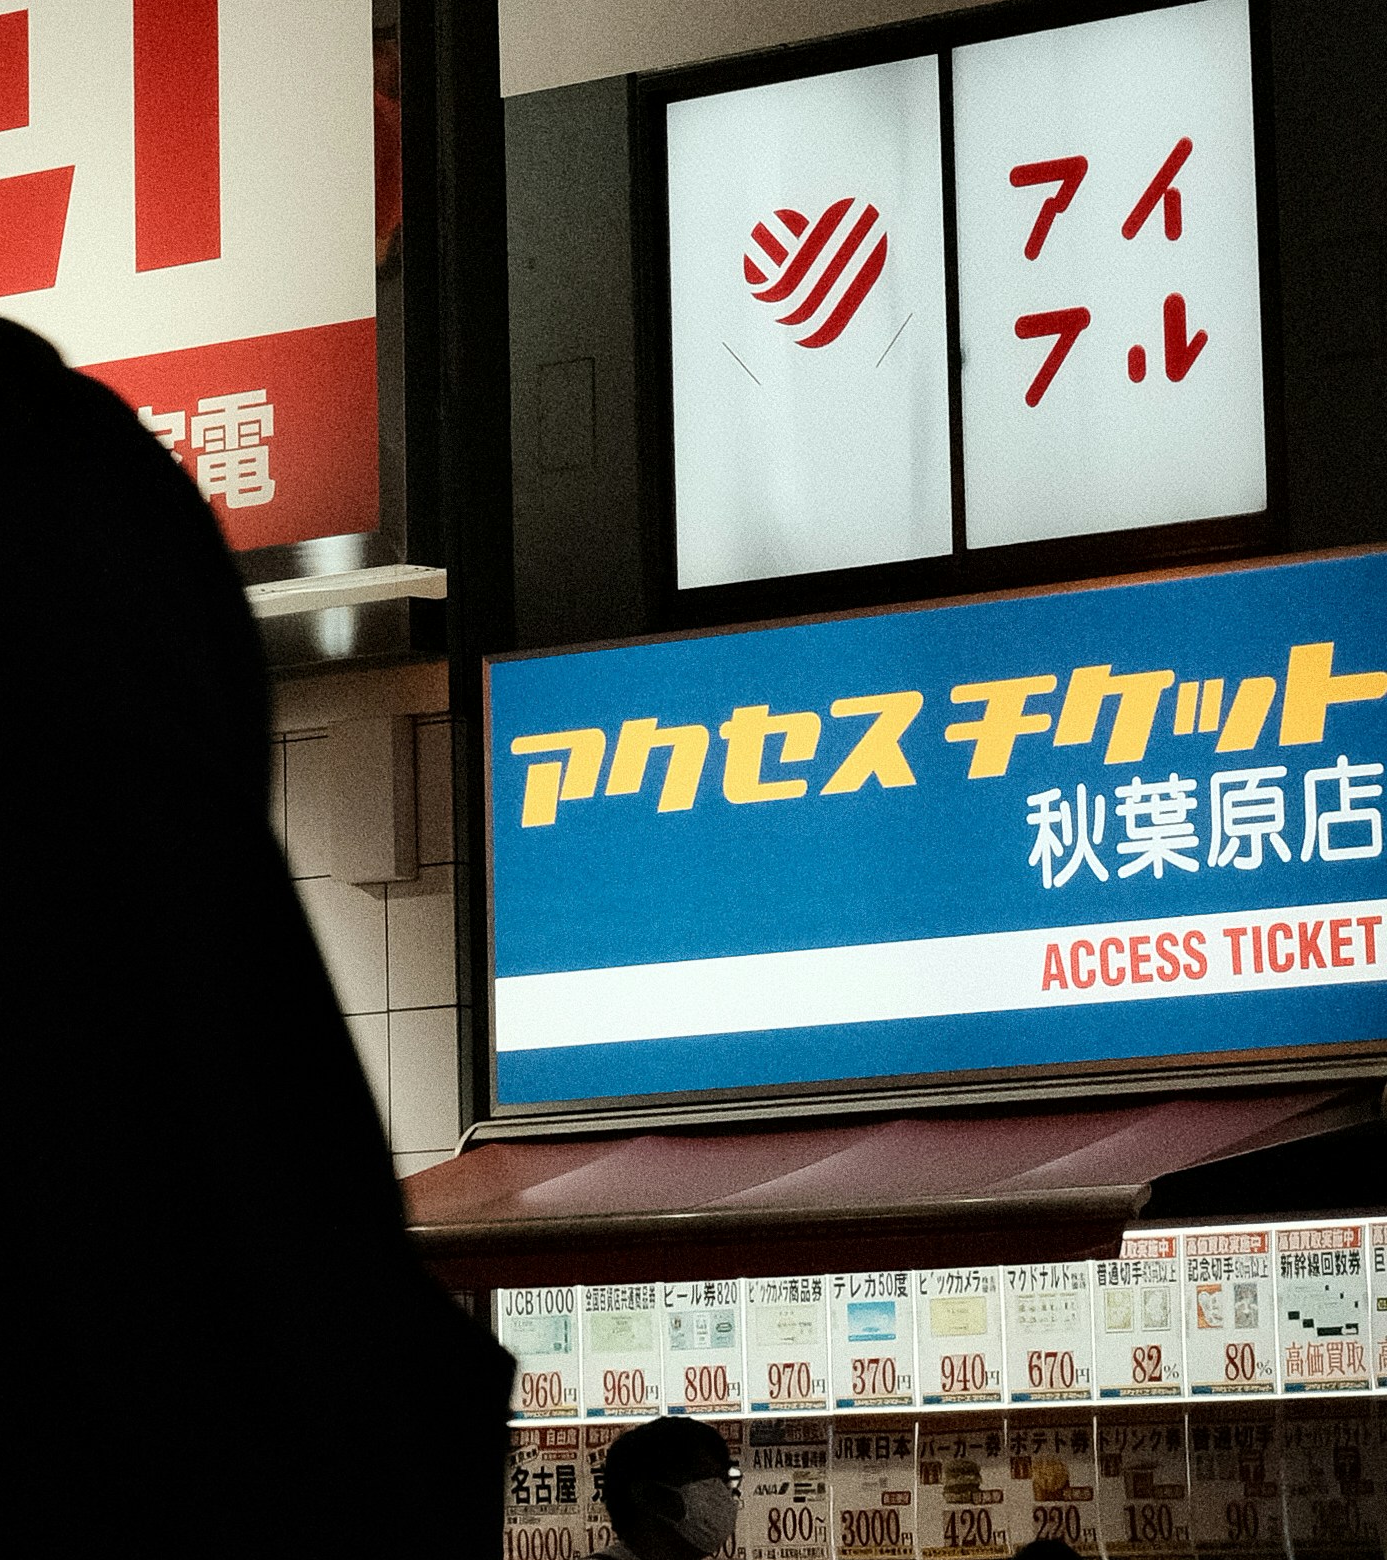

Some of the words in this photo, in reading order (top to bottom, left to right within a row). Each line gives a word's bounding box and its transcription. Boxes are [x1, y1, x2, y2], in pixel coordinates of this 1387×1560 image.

[1027, 755, 1385, 890] 秋葉原店
[1041, 930, 1208, 993] ACCESS
[1221, 916, 1383, 976] TICKET
[1280, 1252, 1361, 1280] 新幹線回数券
[505, 1288, 575, 1316] JCB1000
[663, 1281, 737, 1307] ビール券820
[833, 1272, 909, 1299] テレカ50度
[851, 1357, 912, 1395] 370円
[940, 1353, 1000, 1393] 940円
[1027, 1350, 1090, 1389] 670円
[1132, 1344, 1180, 1384] 82%
[1225, 1342, 1273, 1382] 80%
[1285, 1341, 1367, 1378] 高価買取
[521, 1370, 577, 1409] 960円
[602, 1368, 659, 1406] 960円
[684, 1365, 741, 1403] 800円
[767, 1361, 826, 1400] 970円
[835, 1436, 911, 1461] JR東日本
[510, 1464, 577, 1505] 名古屋
[840, 1509, 914, 1547] 3000円
[943, 1509, 1006, 1547] 420円
